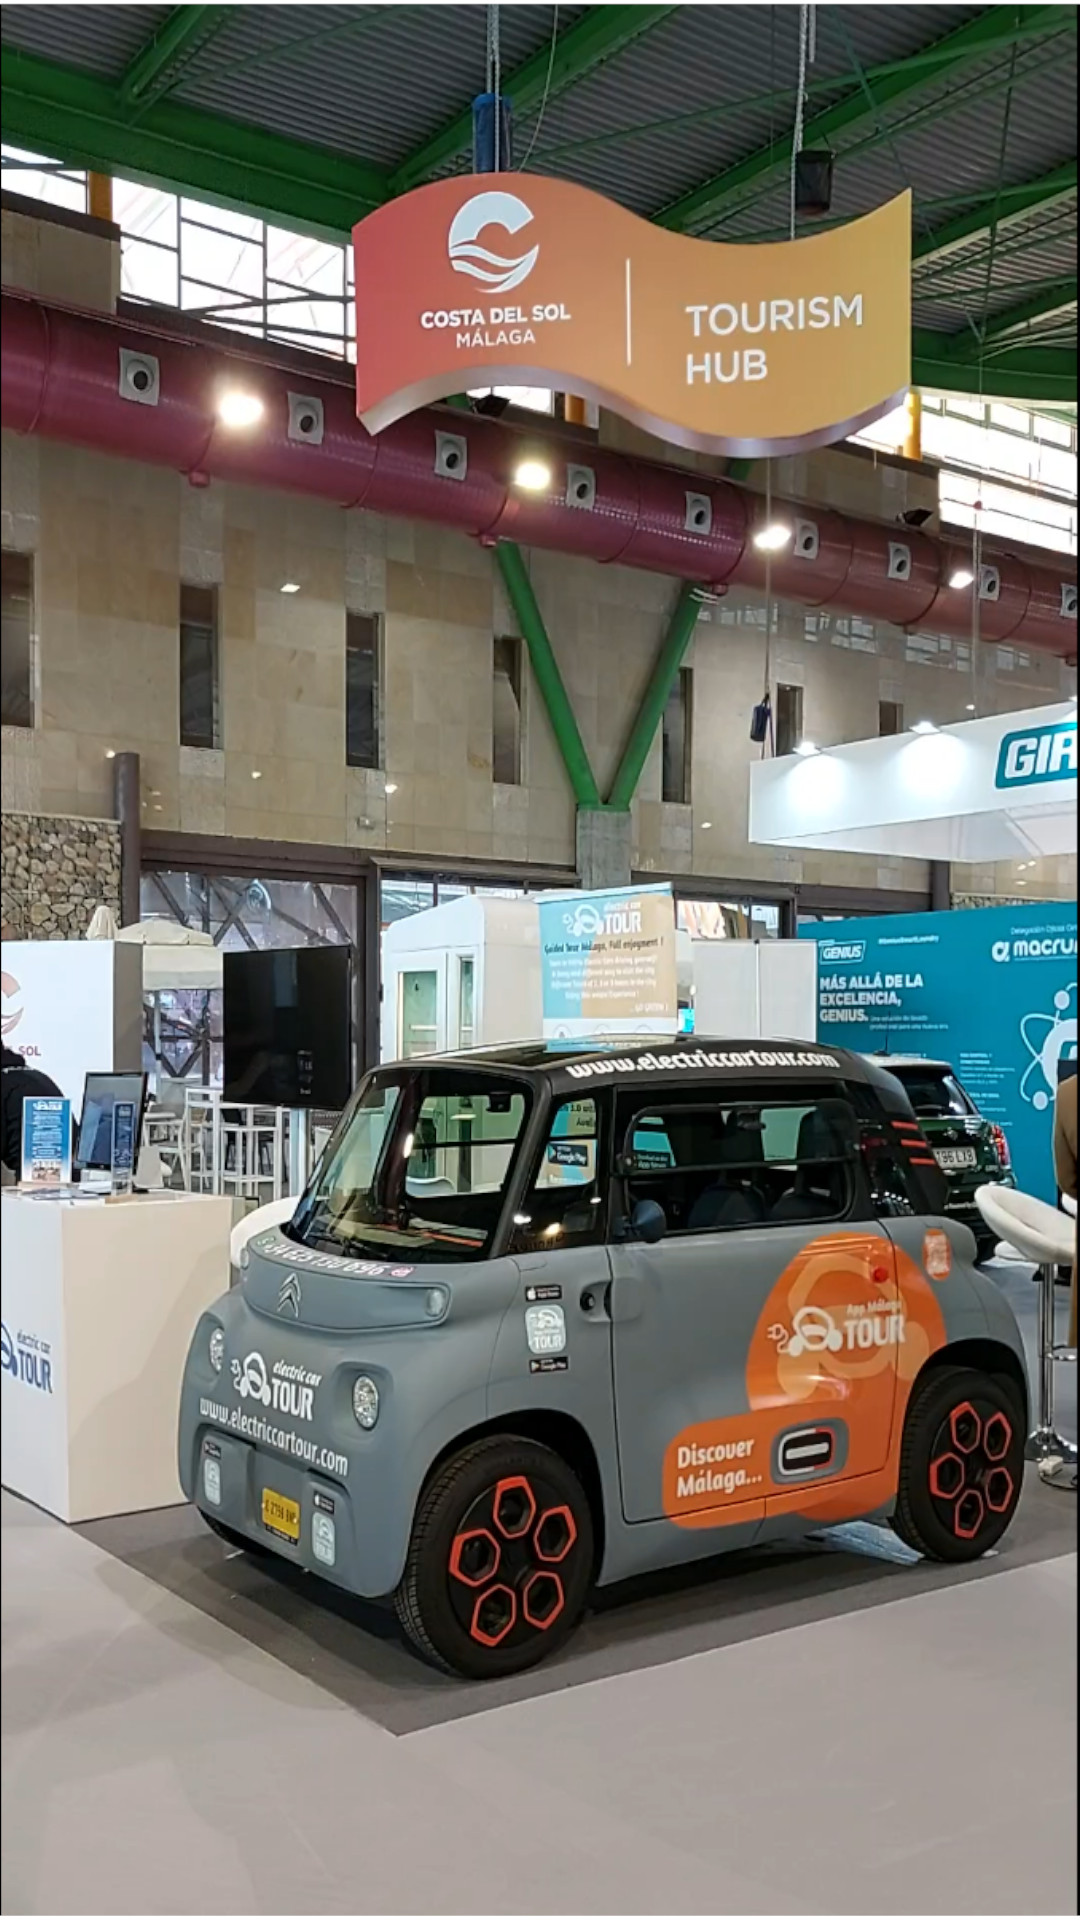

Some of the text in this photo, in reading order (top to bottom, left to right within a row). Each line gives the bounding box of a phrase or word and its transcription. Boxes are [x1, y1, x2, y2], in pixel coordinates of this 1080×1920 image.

[420, 303, 572, 329] COSTA DEL SOL
[685, 294, 863, 337] TOURISM
[456, 328, 536, 349] MÁLAGA
[687, 349, 768, 385] HUB
[604, 910, 642, 935] TOUR
[823, 945, 862, 960] GENIUS
[820, 971, 924, 990] MÁS ALLÁ DE LA
[820, 991, 902, 1007] EXCELENCIA,
[820, 1008, 869, 1022] GENIUS.
[19, 1045, 42, 1056] SOL
[565, 1049, 841, 1078] www.electriccartour.com
[533, 1334, 561, 1350] TOUR
[844, 1315, 906, 1350] TOUR
[18, 1348, 53, 1394] TOUR
[273, 1359, 322, 1387] electric car
[271, 1377, 314, 1421] TOUR
[200, 1397, 348, 1477] www.electriccartour.com
[677, 1438, 755, 1470] Discover
[677, 1469, 763, 1498] Málaga...
